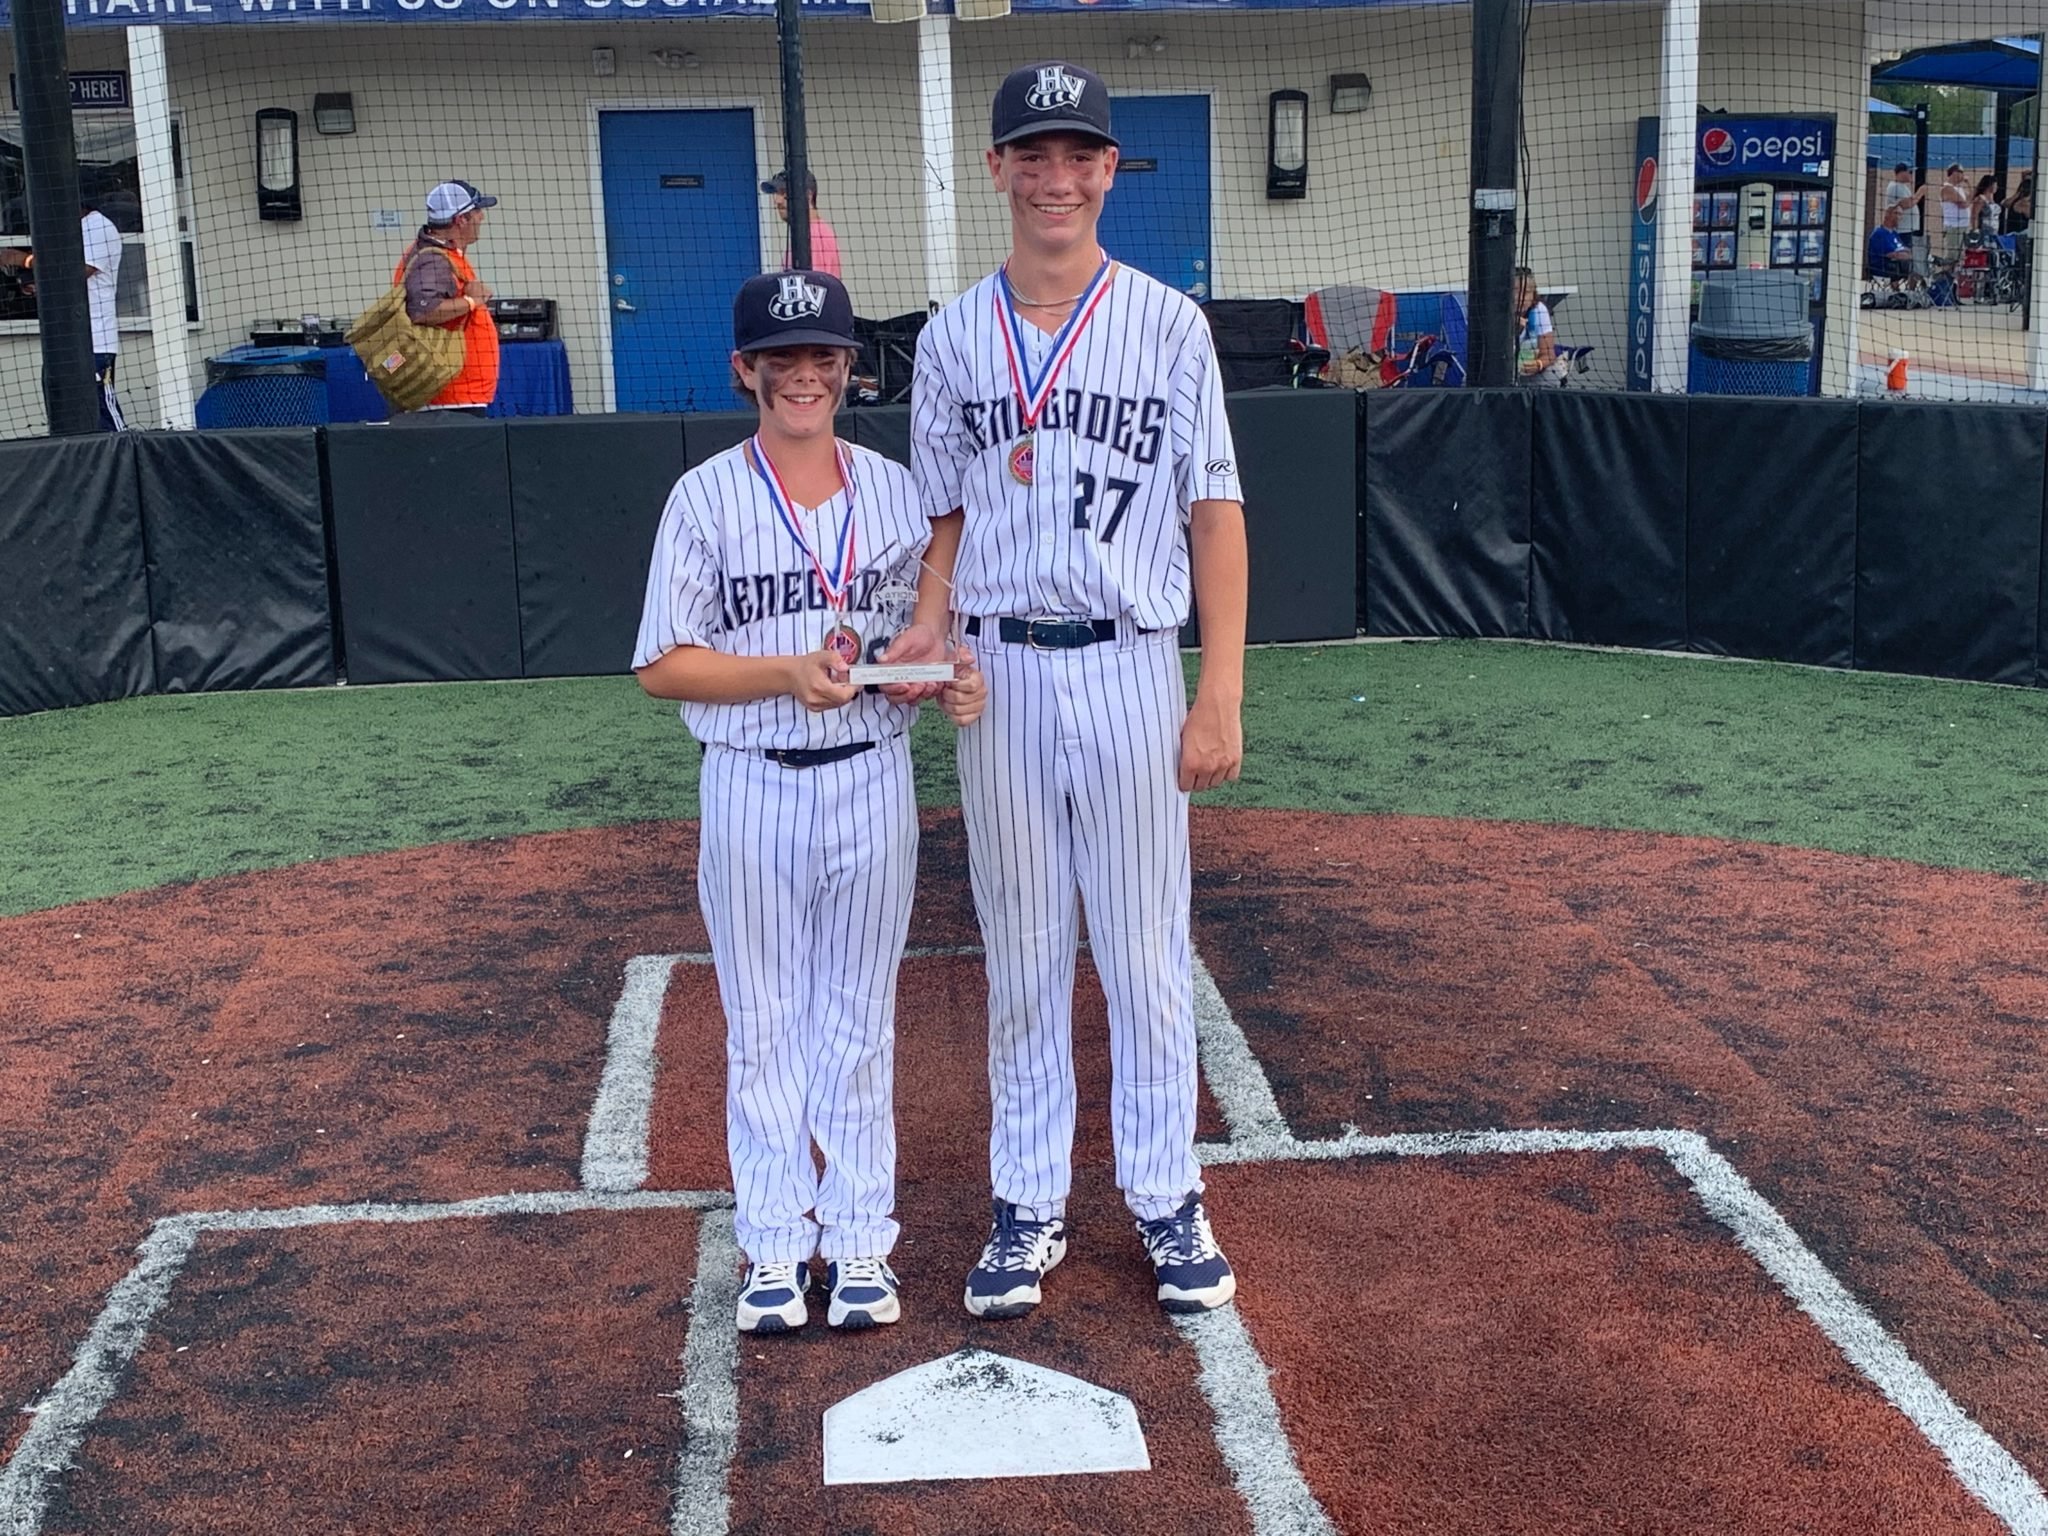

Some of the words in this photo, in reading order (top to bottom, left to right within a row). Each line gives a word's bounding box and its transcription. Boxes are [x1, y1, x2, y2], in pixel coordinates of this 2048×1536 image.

[79, 80, 119, 99] HERE
[1742, 131, 1822, 164] pepsi
[1635, 243, 1650, 379] pepsi
[961, 388, 1167, 465] ENGADES
[1073, 469, 1142, 544] 27
